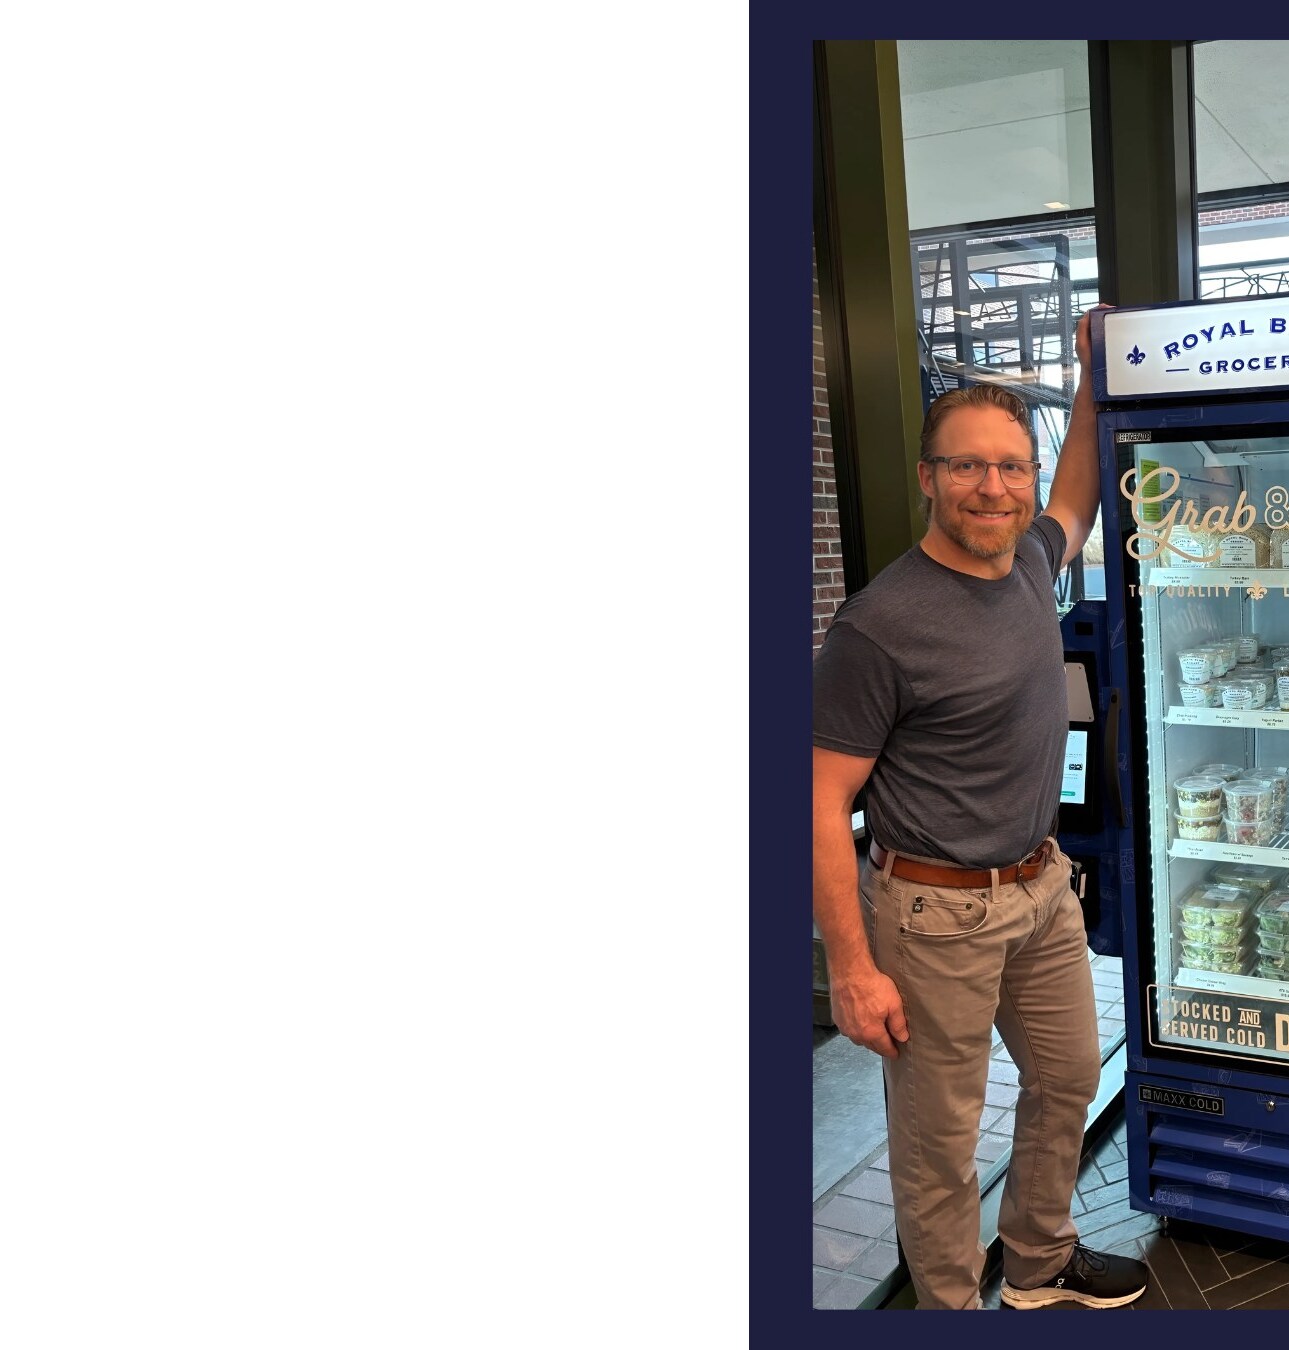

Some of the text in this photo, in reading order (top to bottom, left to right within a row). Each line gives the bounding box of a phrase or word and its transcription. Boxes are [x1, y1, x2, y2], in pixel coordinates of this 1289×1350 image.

[1163, 319, 1254, 362] ROYAL
[1120, 466, 1257, 562] Grab
[1167, 584, 1231, 597] QUALITY
[1162, 1000, 1260, 1025] STOCKED AND
[1162, 1020, 1266, 1049] SERVED COLD
[1153, 1090, 1220, 1111] MAXX COLD
